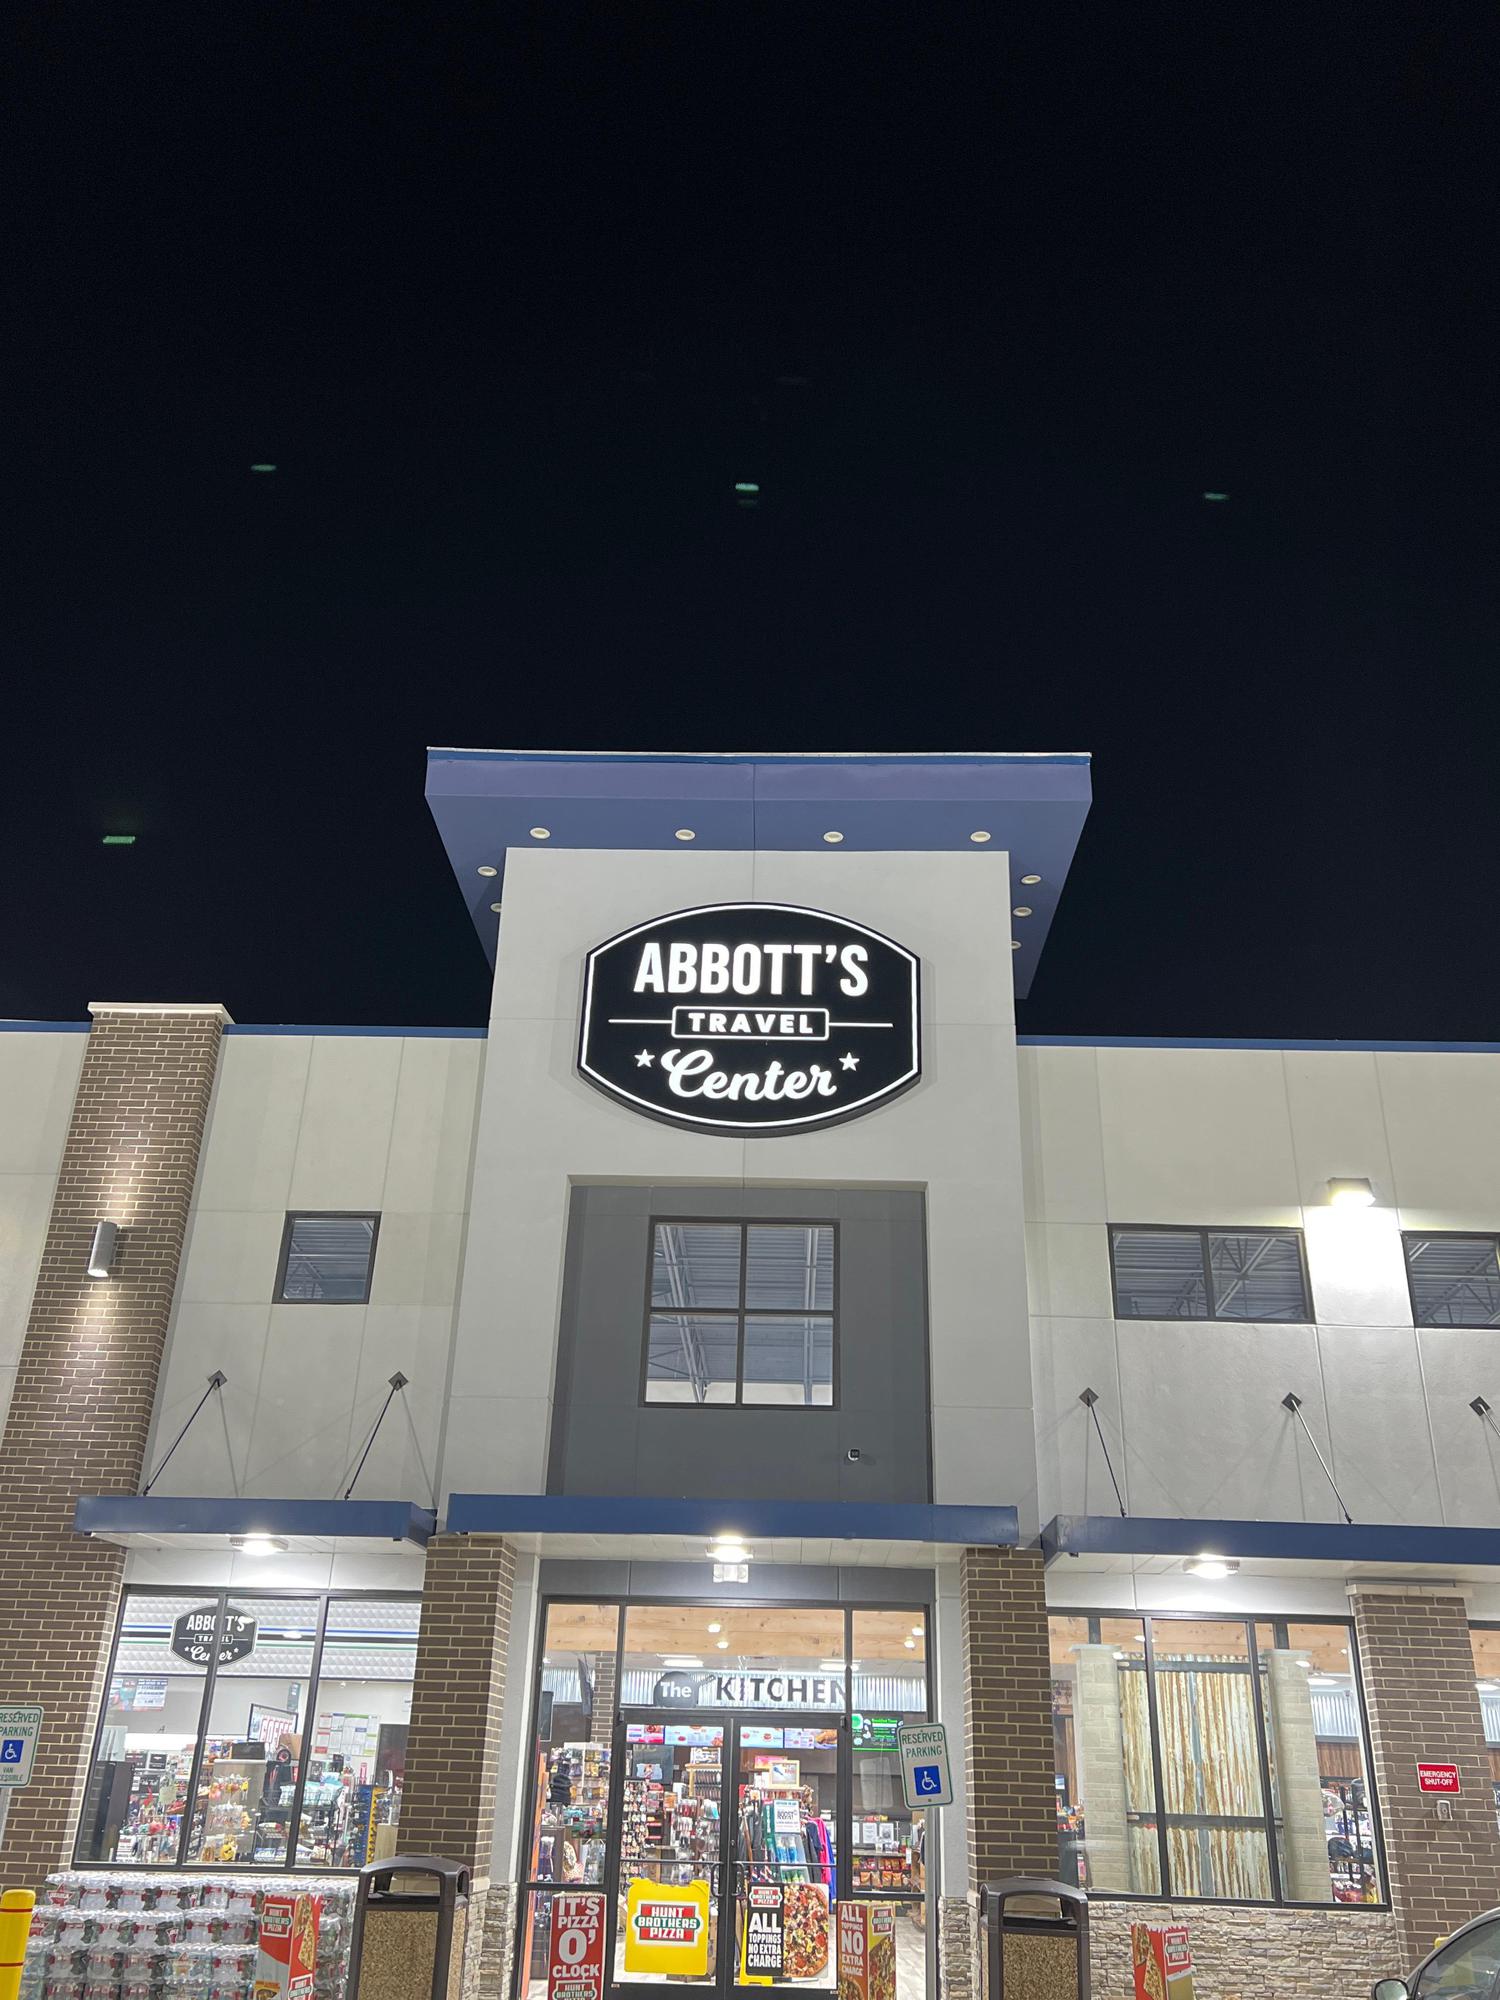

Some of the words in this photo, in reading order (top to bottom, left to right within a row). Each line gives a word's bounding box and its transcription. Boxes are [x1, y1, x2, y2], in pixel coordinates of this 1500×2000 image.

[633, 942, 869, 997] ABBOTT'S
[688, 1012, 814, 1034] TRAVEL
[660, 1048, 837, 1101] Center
[660, 1681, 692, 1698] The
[716, 1677, 846, 1704] KITCHEN
[901, 1731, 944, 1744] RESERVED
[905, 1746, 943, 1758] PARKING
[1420, 1770, 1456, 1779] EMERGENCY
[1424, 1778, 1454, 1786] SHUT-OFF
[558, 1897, 600, 1916] IT'S
[651, 1906, 685, 1918] HUNT
[842, 1905, 863, 1923] ALL
[557, 1916, 600, 1929] PIZZA
[638, 1917, 697, 1929] BROTHERS
[748, 1912, 782, 1933] ALL
[650, 1927, 685, 1939] PIZZA
[749, 1933, 782, 1944] TOPPINGS
[558, 1928, 596, 1965] O'
[749, 1944, 758, 1954] NO
[760, 1944, 782, 1954] EXTRA
[841, 1930, 864, 1956] NO
[748, 1954, 782, 1968] CHARGE
[842, 1954, 864, 1967] EXTRA
[552, 1964, 600, 1978] CLOCK
[556, 1990, 594, 1999] BROTHERS
[564, 1984, 586, 1992] HUNT
